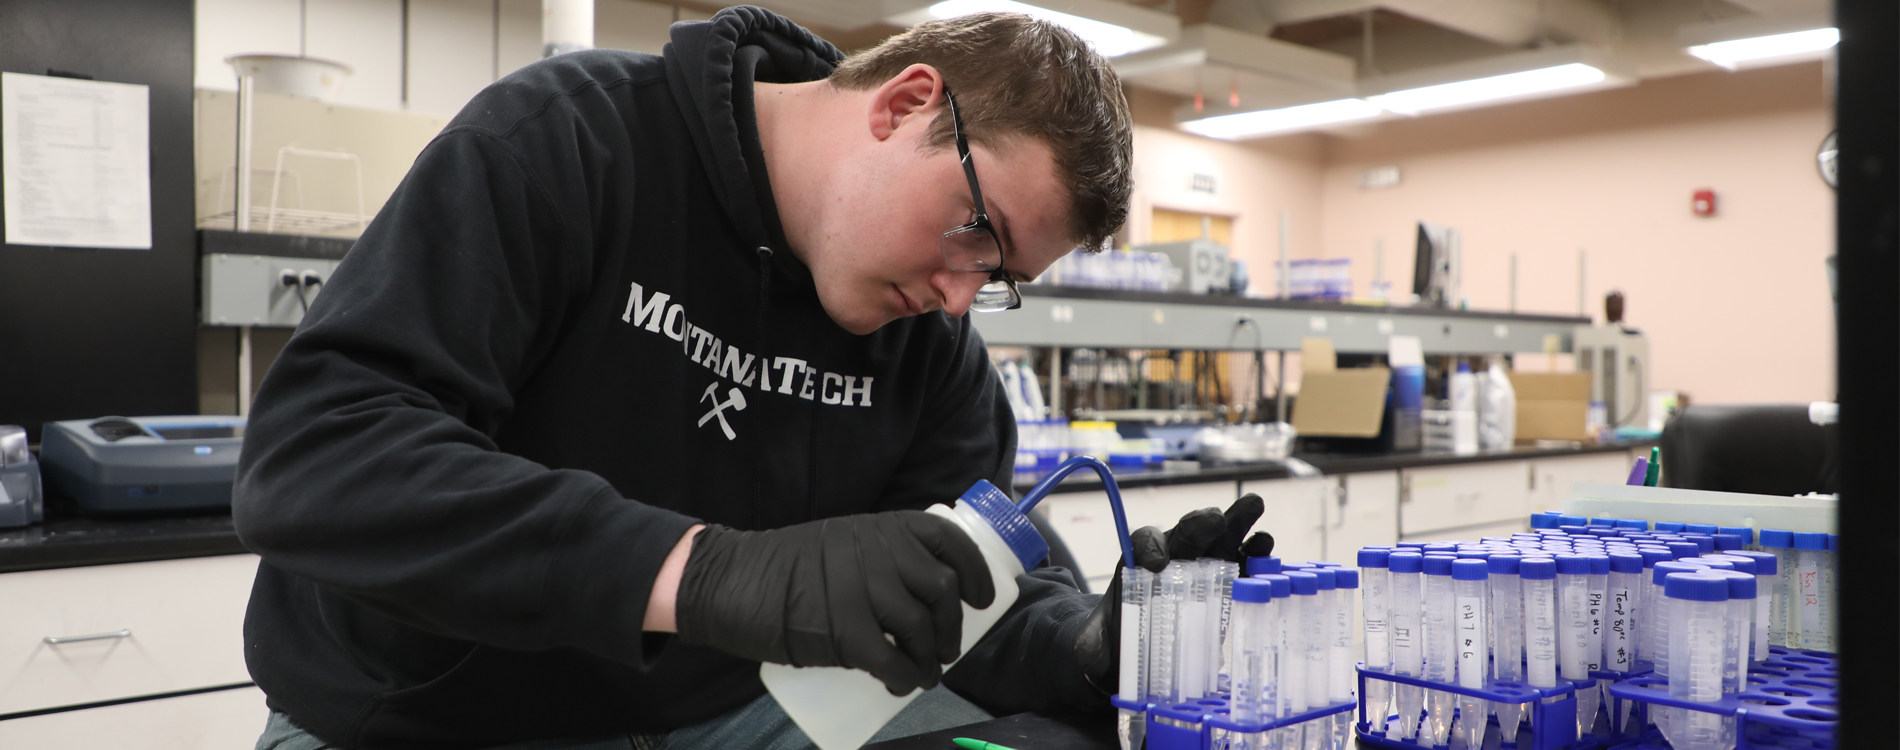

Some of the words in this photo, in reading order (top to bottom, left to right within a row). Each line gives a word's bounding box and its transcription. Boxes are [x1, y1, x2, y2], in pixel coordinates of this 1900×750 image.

[772, 356, 874, 407] TECH
[1804, 572, 1816, 588] Kin
[1614, 591, 1628, 615] Temp
